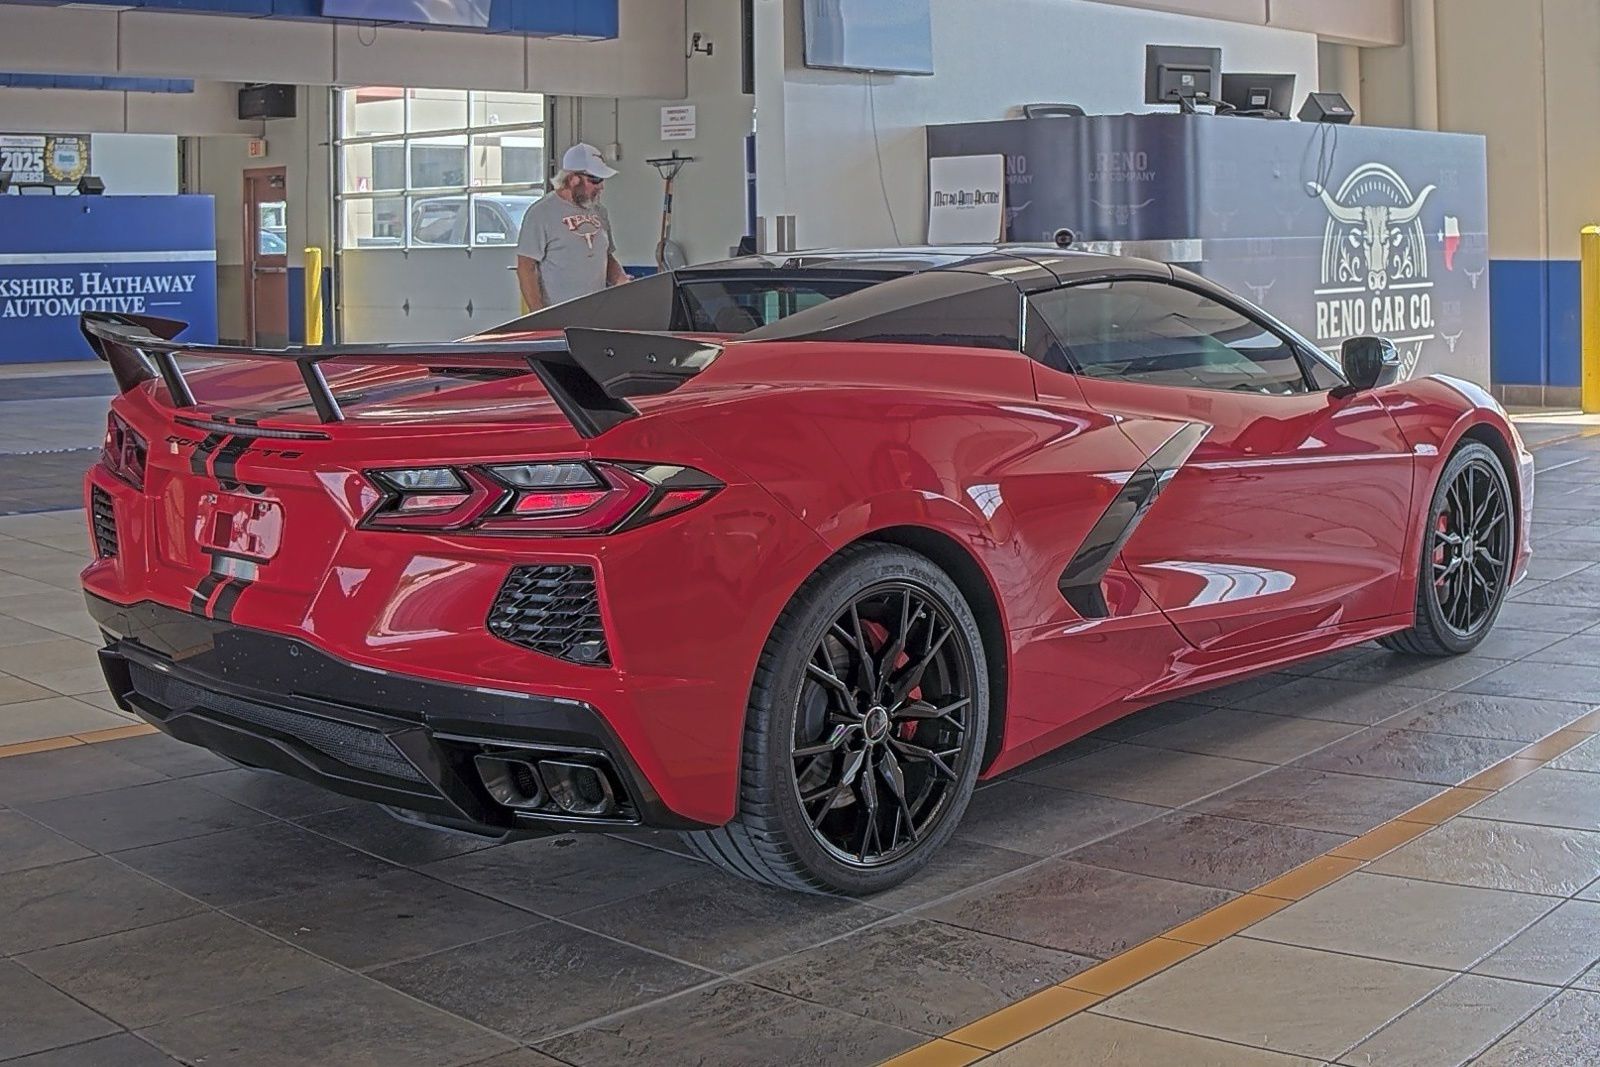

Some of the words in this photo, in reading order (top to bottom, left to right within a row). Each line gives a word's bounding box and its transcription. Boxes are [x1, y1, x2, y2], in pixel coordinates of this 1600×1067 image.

[1, 152, 44, 172] 2025
[1006, 155, 1026, 174] NO
[1097, 151, 1148, 171] RENO
[1110, 172, 1157, 183] COMPANY
[79, 272, 196, 295] HATHAWAY
[1, 296, 146, 318] AUTOMOTIVE
[1316, 298, 1366, 340] RENO
[1371, 294, 1405, 334] CAR
[1410, 293, 1435, 330] CO.
